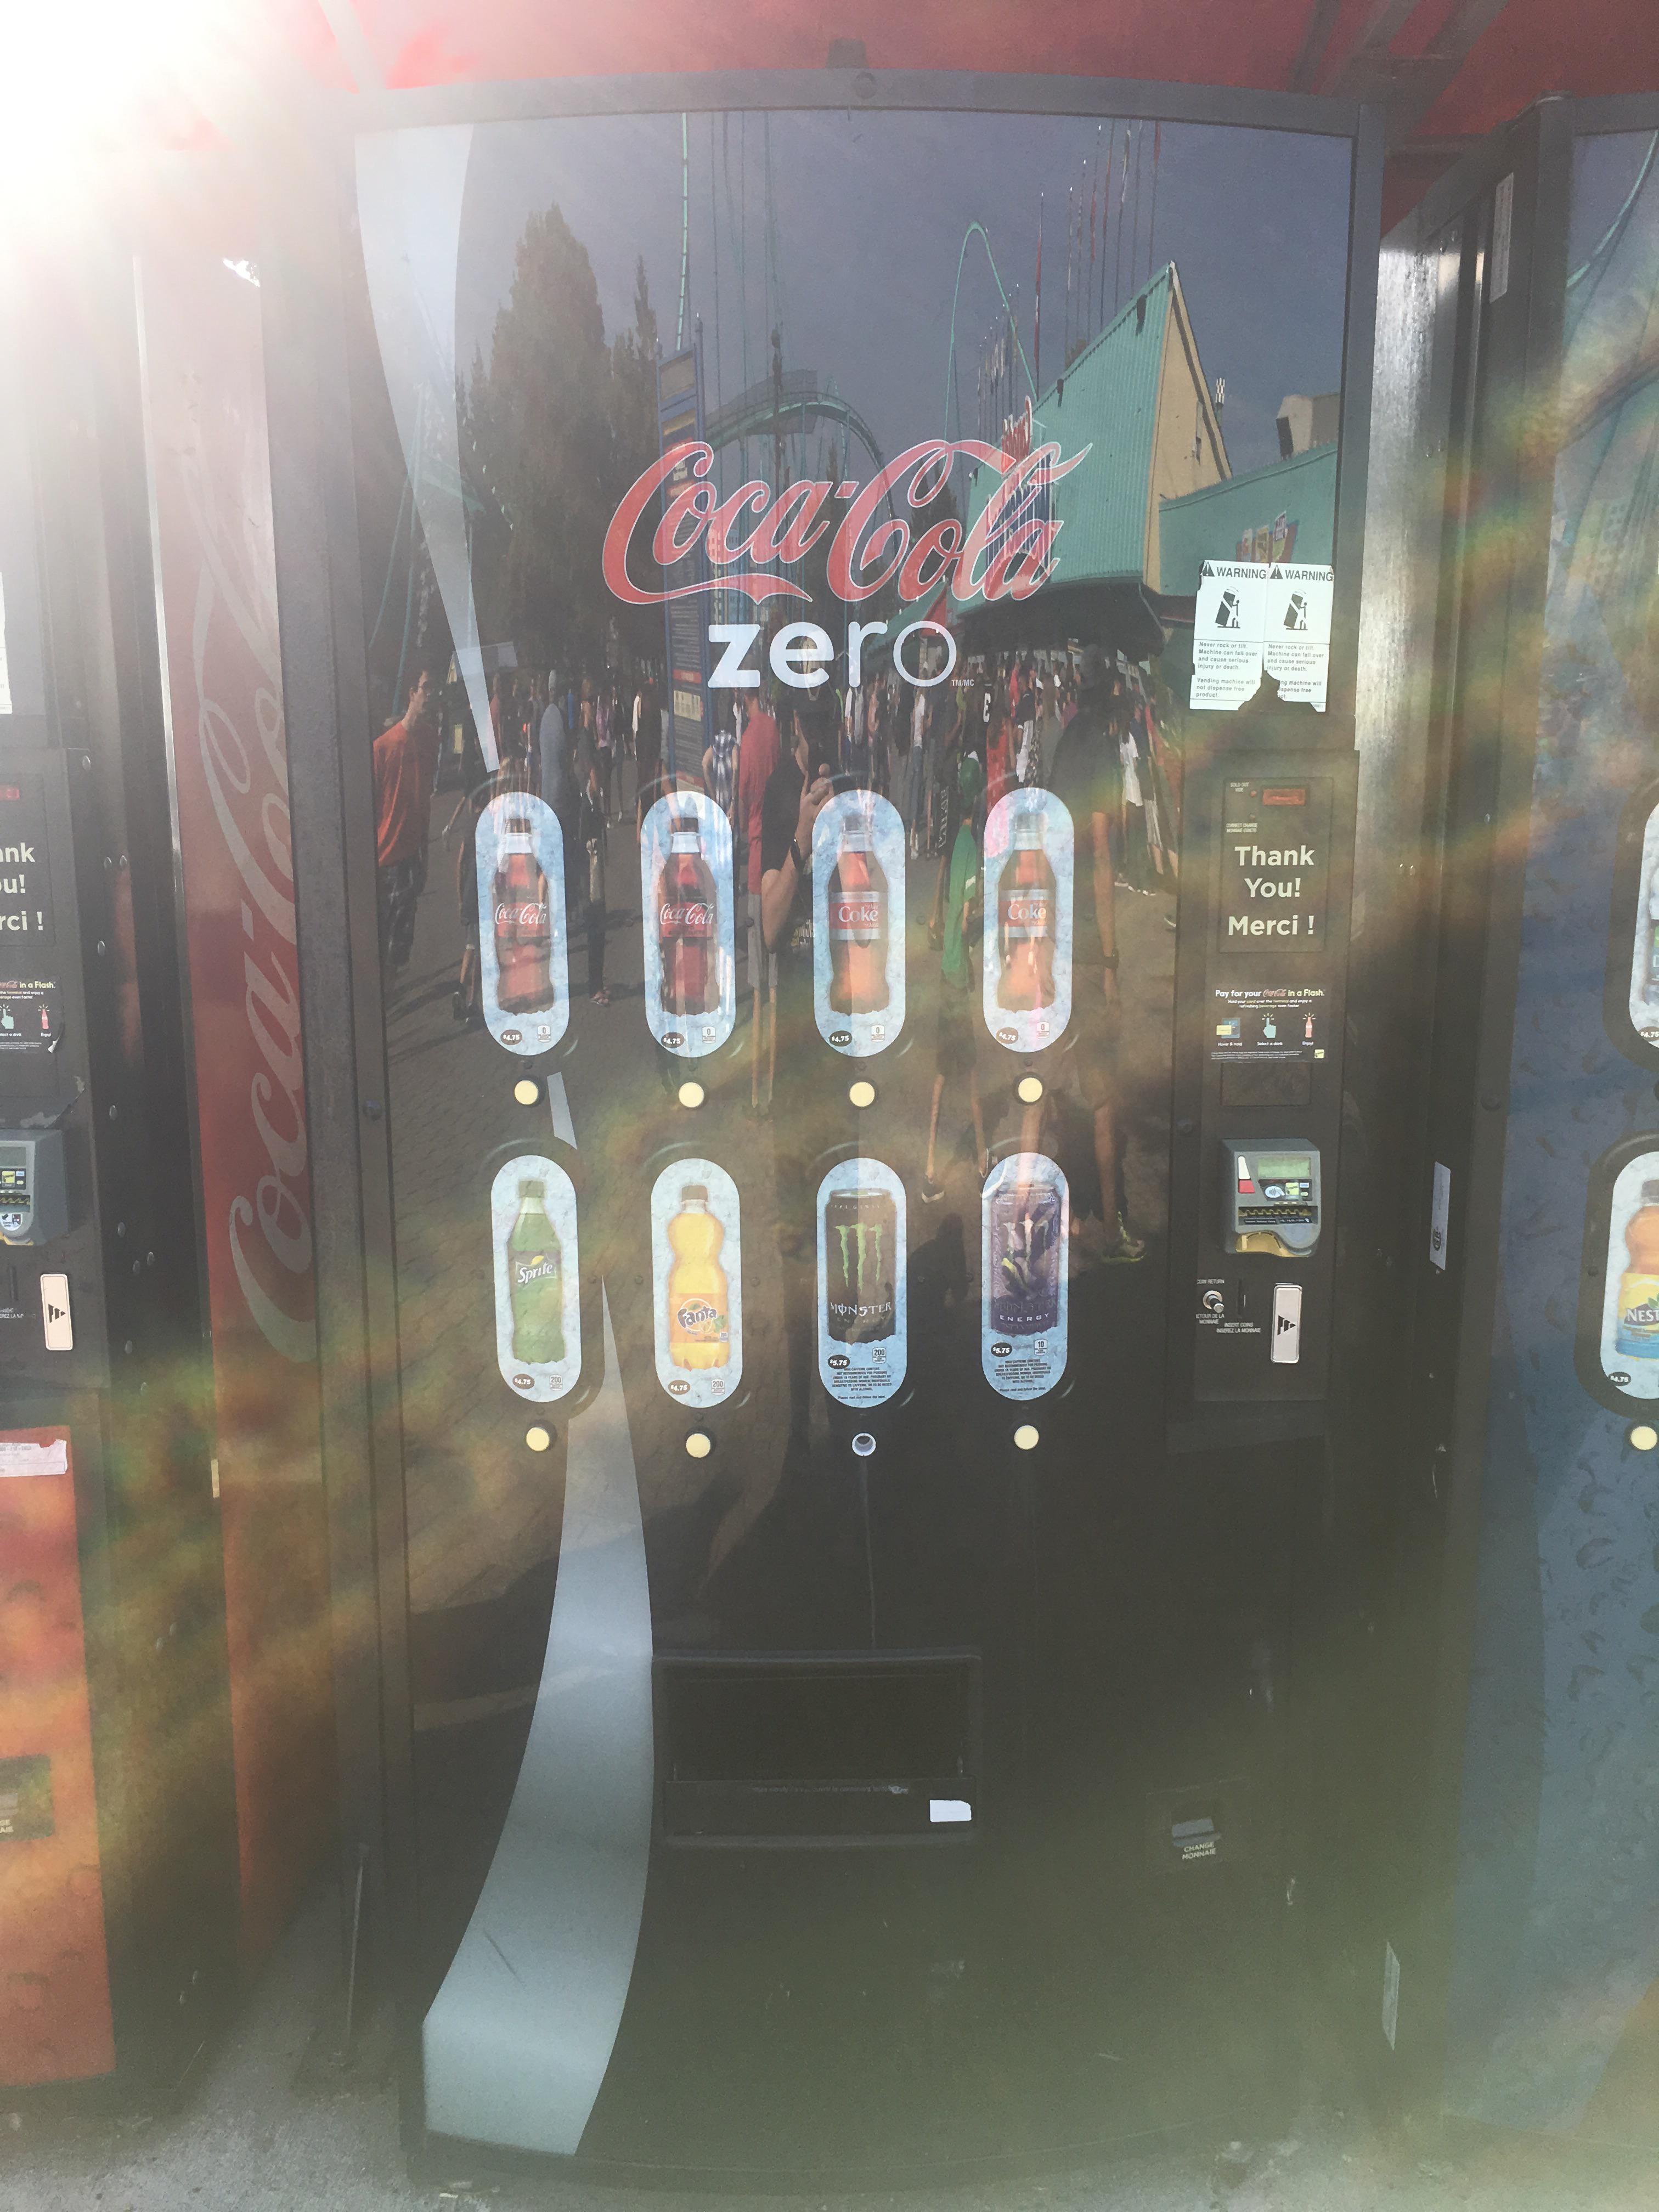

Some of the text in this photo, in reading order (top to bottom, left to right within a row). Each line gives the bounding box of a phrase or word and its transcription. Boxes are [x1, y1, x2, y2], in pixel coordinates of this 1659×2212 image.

[602, 439, 1093, 605] Coca-Cola
[1217, 567, 1267, 579] WARNING
[1285, 569, 1333, 581] WARNING
[707, 620, 957, 689] zero
[1234, 845, 1315, 866] Thank
[1244, 878, 1301, 898] You!
[495, 902, 547, 925] Coca-Cola
[659, 902, 714, 925] Coca-Cola
[838, 906, 878, 922] Coke
[1008, 904, 1047, 920] Coke
[1228, 915, 1299, 935] Merci
[1215, 990, 1229, 998] Pay
[998, 1032, 1016, 1041] $4.75
[517, 1262, 554, 1285] Sprite
[677, 1306, 717, 1328] Fanta
[830, 1302, 891, 1317] MONSTER
[1000, 1313, 1049, 1322] ENERGY
[514, 1378, 531, 1386] $4.75
[1182, 1848, 1216, 1860] MONNAIE
[1184, 1842, 1214, 1853] CHANGE
